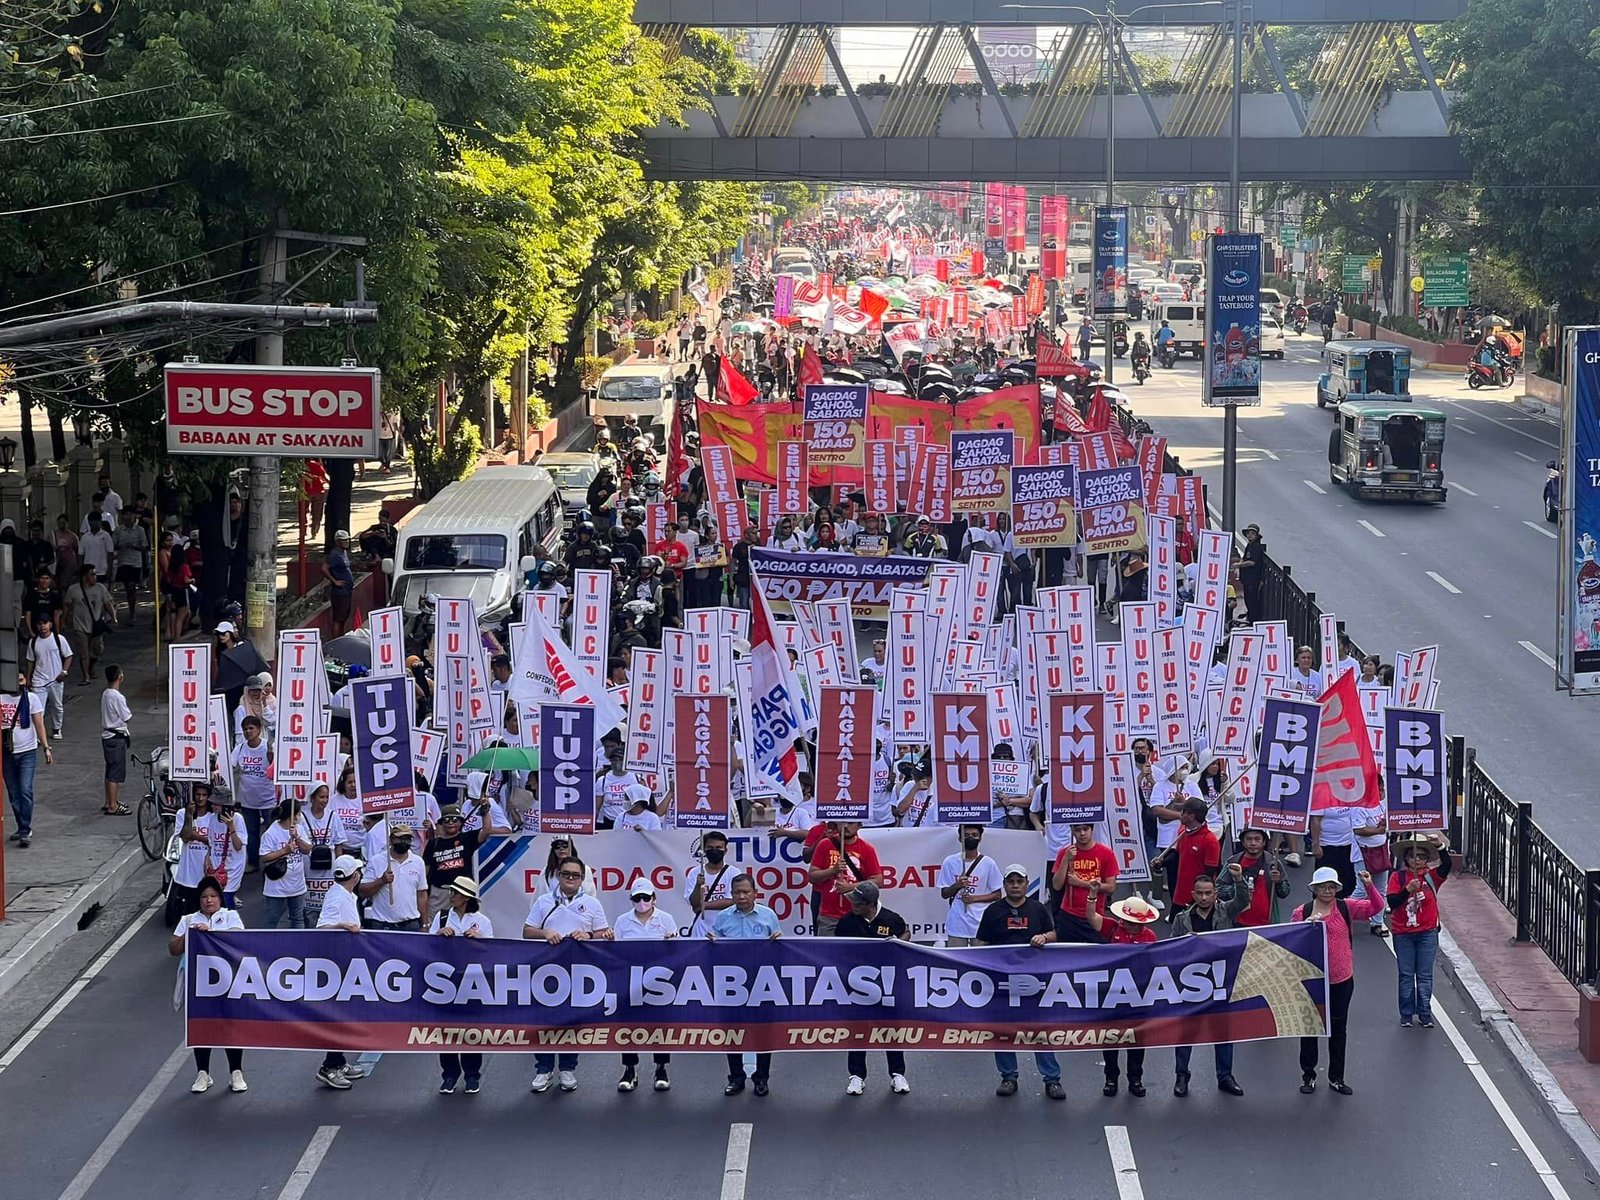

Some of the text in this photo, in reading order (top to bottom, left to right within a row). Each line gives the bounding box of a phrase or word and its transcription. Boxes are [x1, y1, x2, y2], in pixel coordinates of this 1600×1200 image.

[178, 387, 362, 417] BUS STOP
[811, 392, 857, 401] DAGDAG
[806, 408, 863, 419] ISABATAS!
[814, 401, 855, 410] SAHOD,
[814, 422, 846, 438] 150
[180, 431, 363, 447] BABAAN AT SAKAYAN
[958, 437, 1004, 450] DAGDAG
[955, 454, 1010, 468] ISABATAS!
[960, 448, 1002, 458] SAHOD,
[873, 443, 888, 511] SENTRO
[962, 468, 995, 486] 150
[1018, 470, 1064, 483] DAGDAG
[1085, 472, 1132, 488] DAGDAG
[930, 454, 948, 520] SENTRO
[1015, 487, 1071, 501] ISABATAS!
[1021, 480, 1062, 492] SAHOD,
[1089, 483, 1131, 496] SAHOD,
[958, 501, 995, 509] SENTRO
[1084, 489, 1139, 507] ISABATAS!
[1023, 502, 1056, 520] 150
[1092, 505, 1126, 526] 150
[1020, 535, 1057, 544] SENTRO
[1092, 539, 1129, 550] SENTRO
[753, 560, 928, 576] DAGDAG SAHOD, ISABATAS!
[835, 692, 855, 800] NAGKAISA
[944, 705, 980, 792] KMU
[1060, 705, 1095, 792] KMU
[553, 711, 581, 810] TUCP
[694, 699, 711, 810] NAGKAISA
[1268, 713, 1308, 802] BMP
[1396, 720, 1434, 803] BMP
[992, 763, 1018, 772] TUCP
[363, 794, 393, 803] NATIONAL
[372, 798, 404, 807] COALITION
[1254, 812, 1305, 823] NATIONAL WAGE
[1262, 819, 1296, 828] COALITION
[195, 954, 412, 1002] DAGDAG
[422, 962, 618, 1016] SAHOD,
[630, 964, 895, 1007] ISABATAS!
[907, 966, 997, 1008] 150
[408, 1027, 745, 1046] NATIONAL WAGE COALITION
[788, 1028, 1137, 1046] TUCP KMU BMP NAGKAISA
